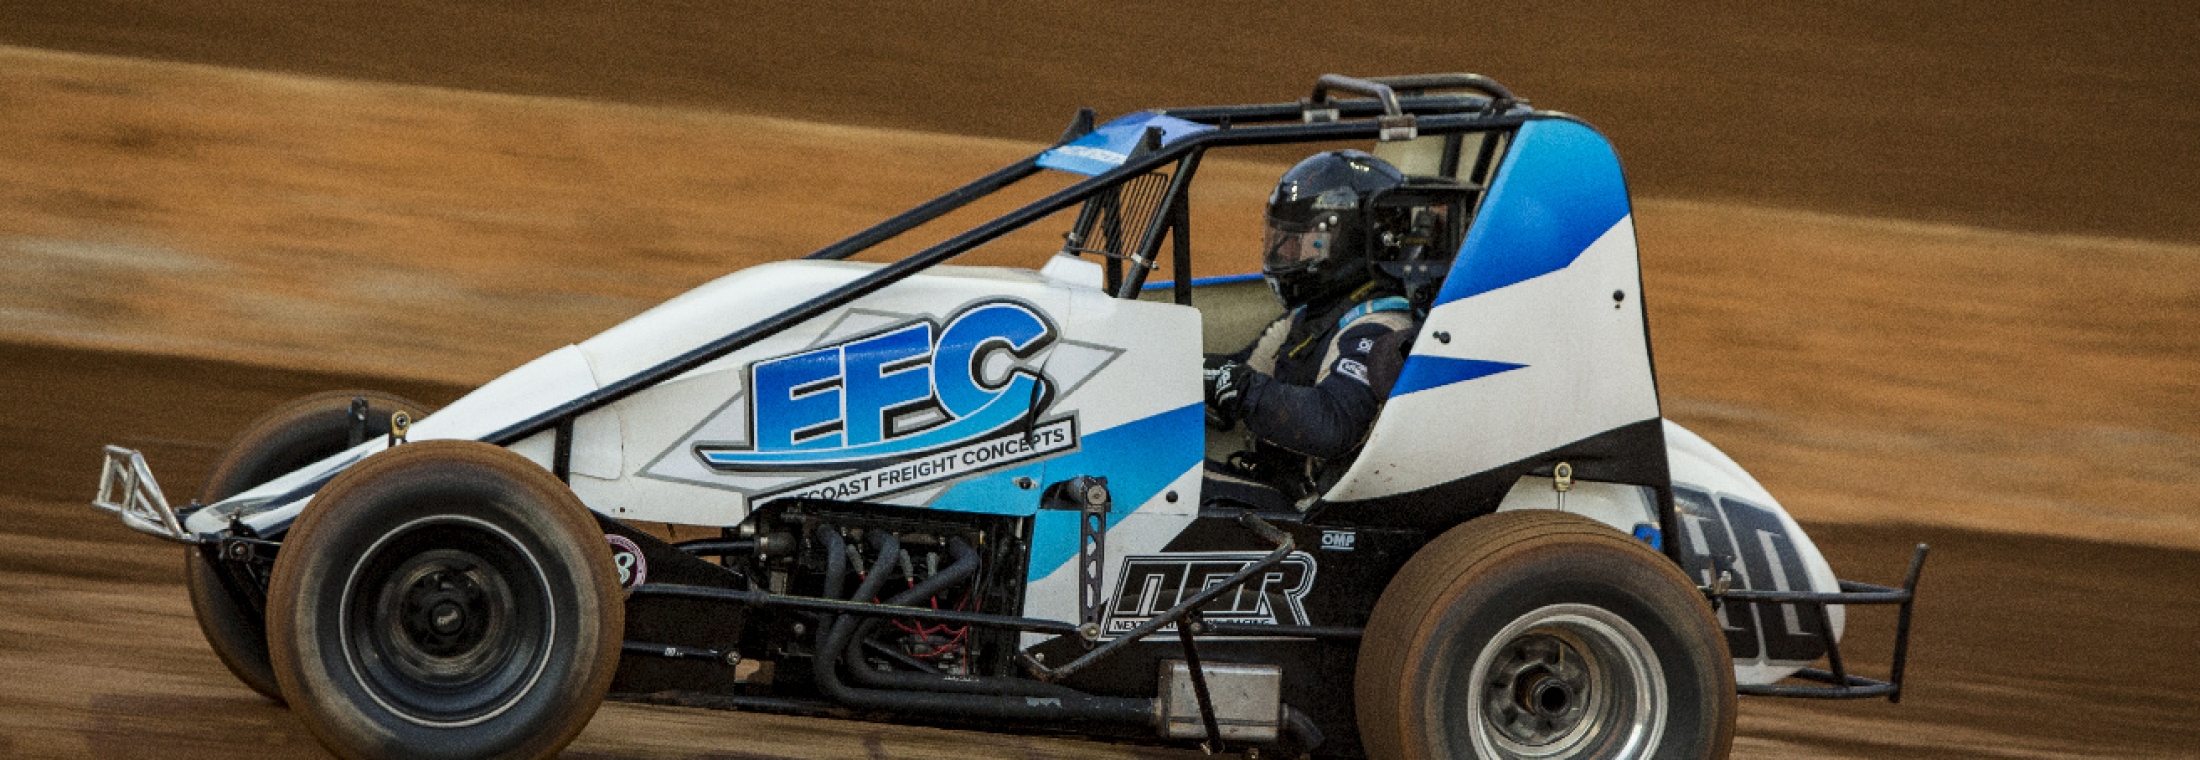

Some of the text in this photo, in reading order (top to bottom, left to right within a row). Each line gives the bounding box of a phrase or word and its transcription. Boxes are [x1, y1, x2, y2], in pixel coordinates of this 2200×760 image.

[749, 297, 1056, 454] EFC
[877, 454, 958, 488] FREIGHT
[961, 428, 1065, 466] CONCEPTS
[1321, 532, 1356, 547] OMP
